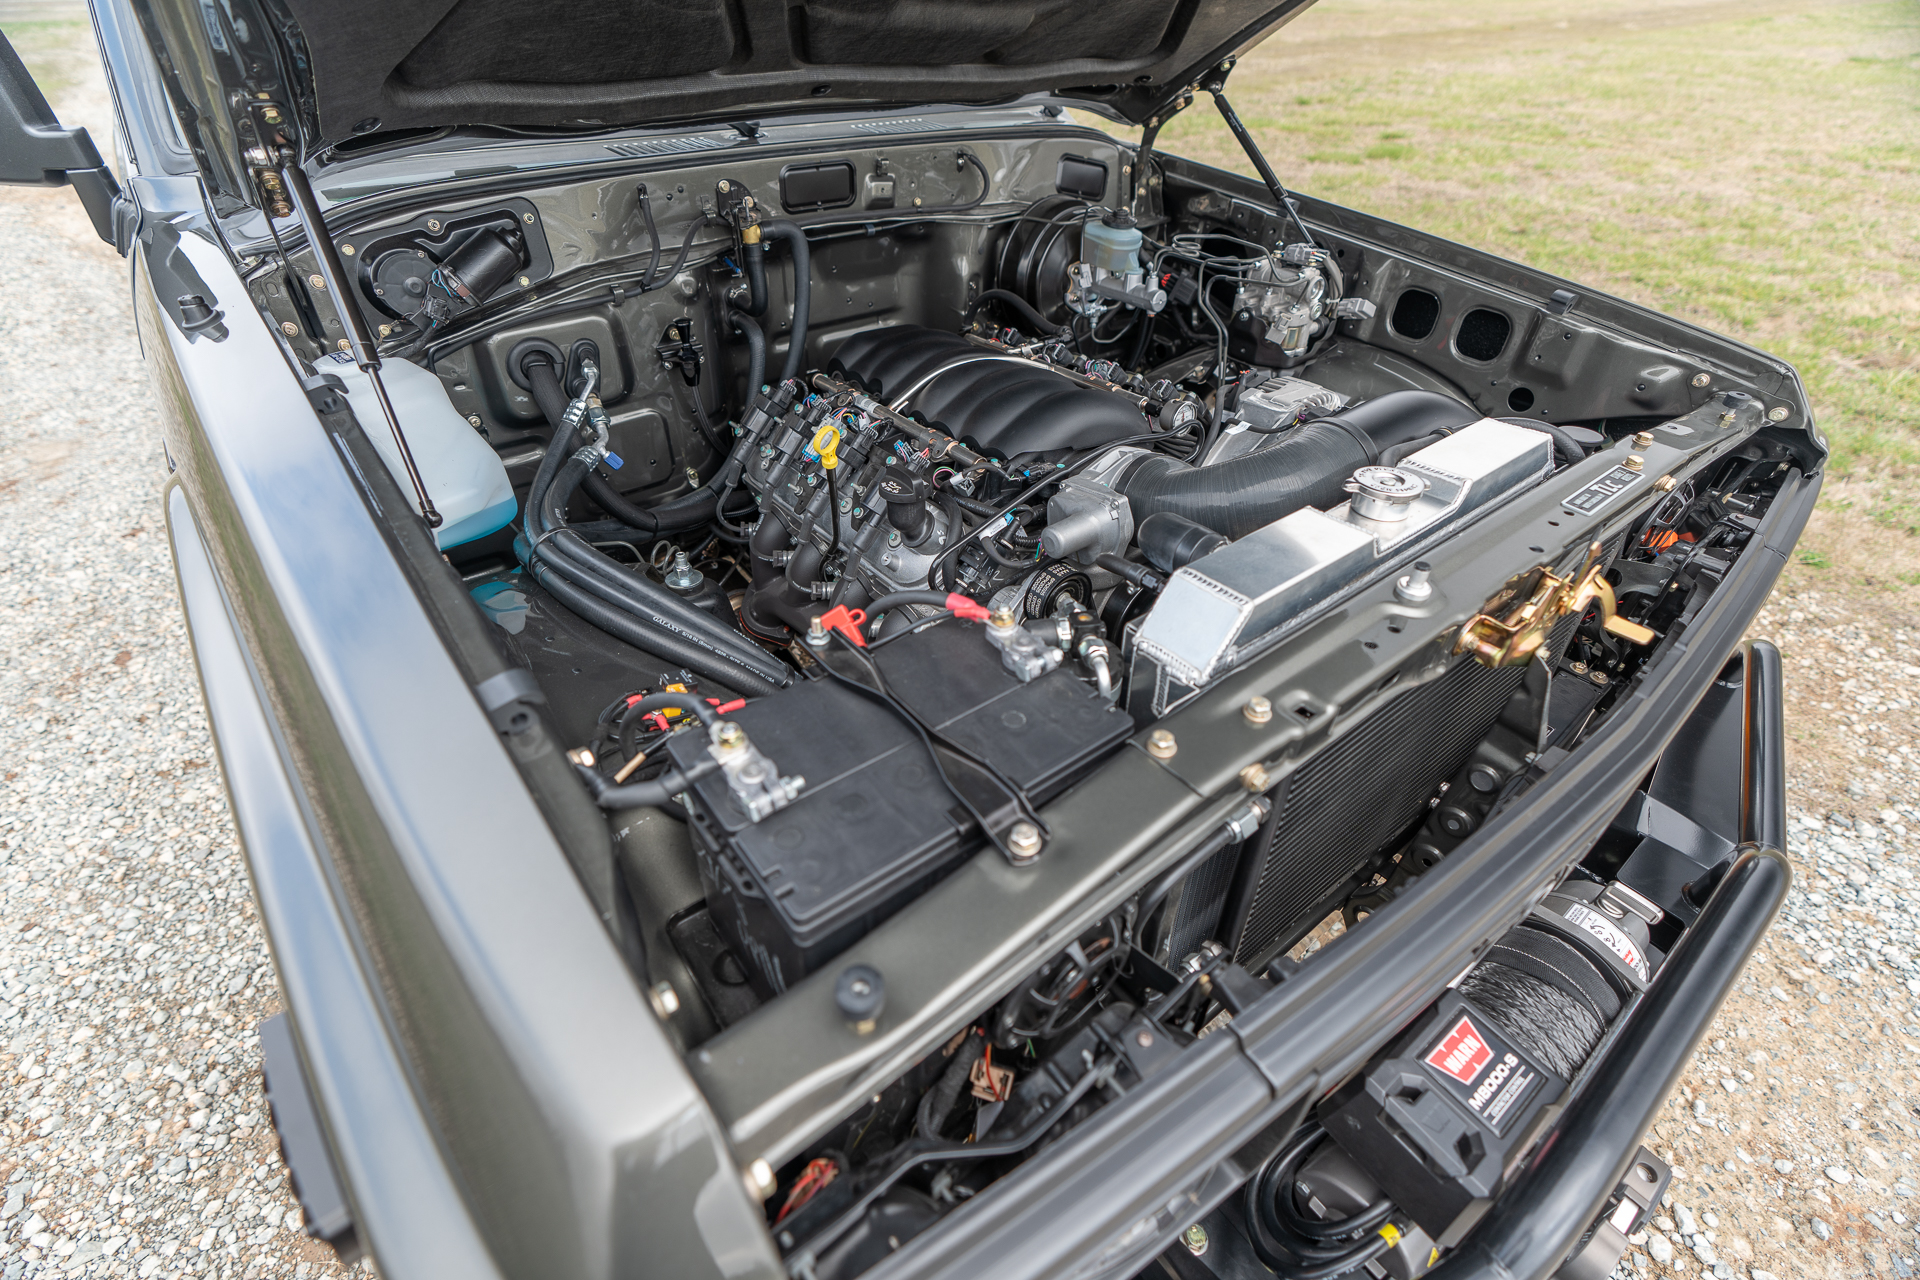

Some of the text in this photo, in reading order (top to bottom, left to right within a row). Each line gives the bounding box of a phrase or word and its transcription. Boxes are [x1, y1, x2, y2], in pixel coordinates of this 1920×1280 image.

[1588, 479, 1624, 496] TLC
[652, 616, 682, 633] GALAXY
[1444, 1035, 1482, 1075] WARN
